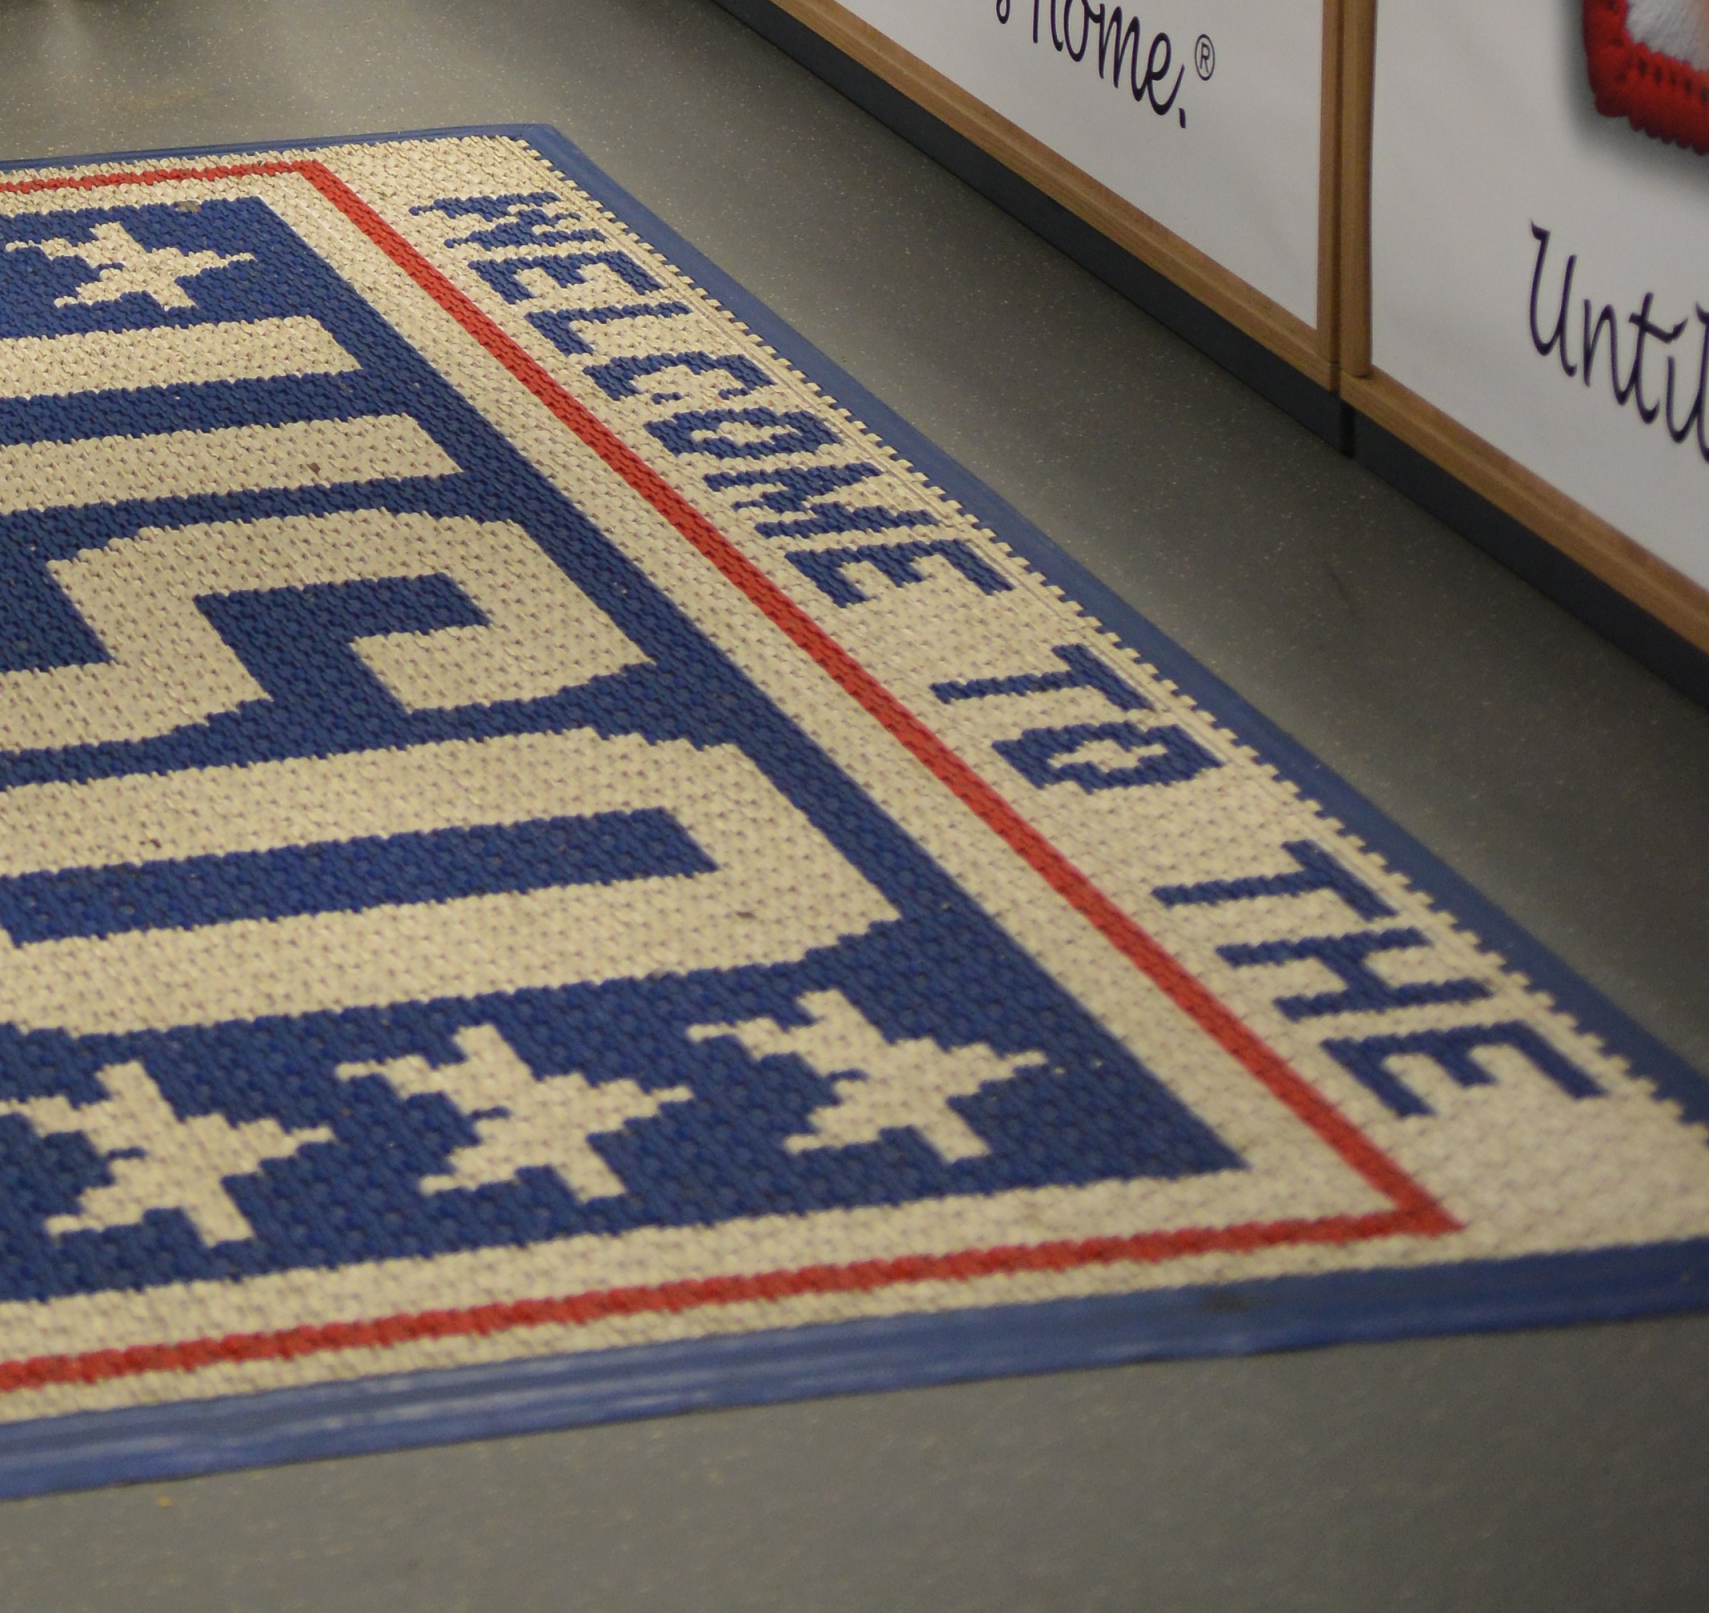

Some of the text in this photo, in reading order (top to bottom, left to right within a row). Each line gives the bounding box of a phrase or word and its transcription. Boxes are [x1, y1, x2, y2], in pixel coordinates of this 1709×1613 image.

[409, 191, 1612, 1118] WELCOME TO THE
